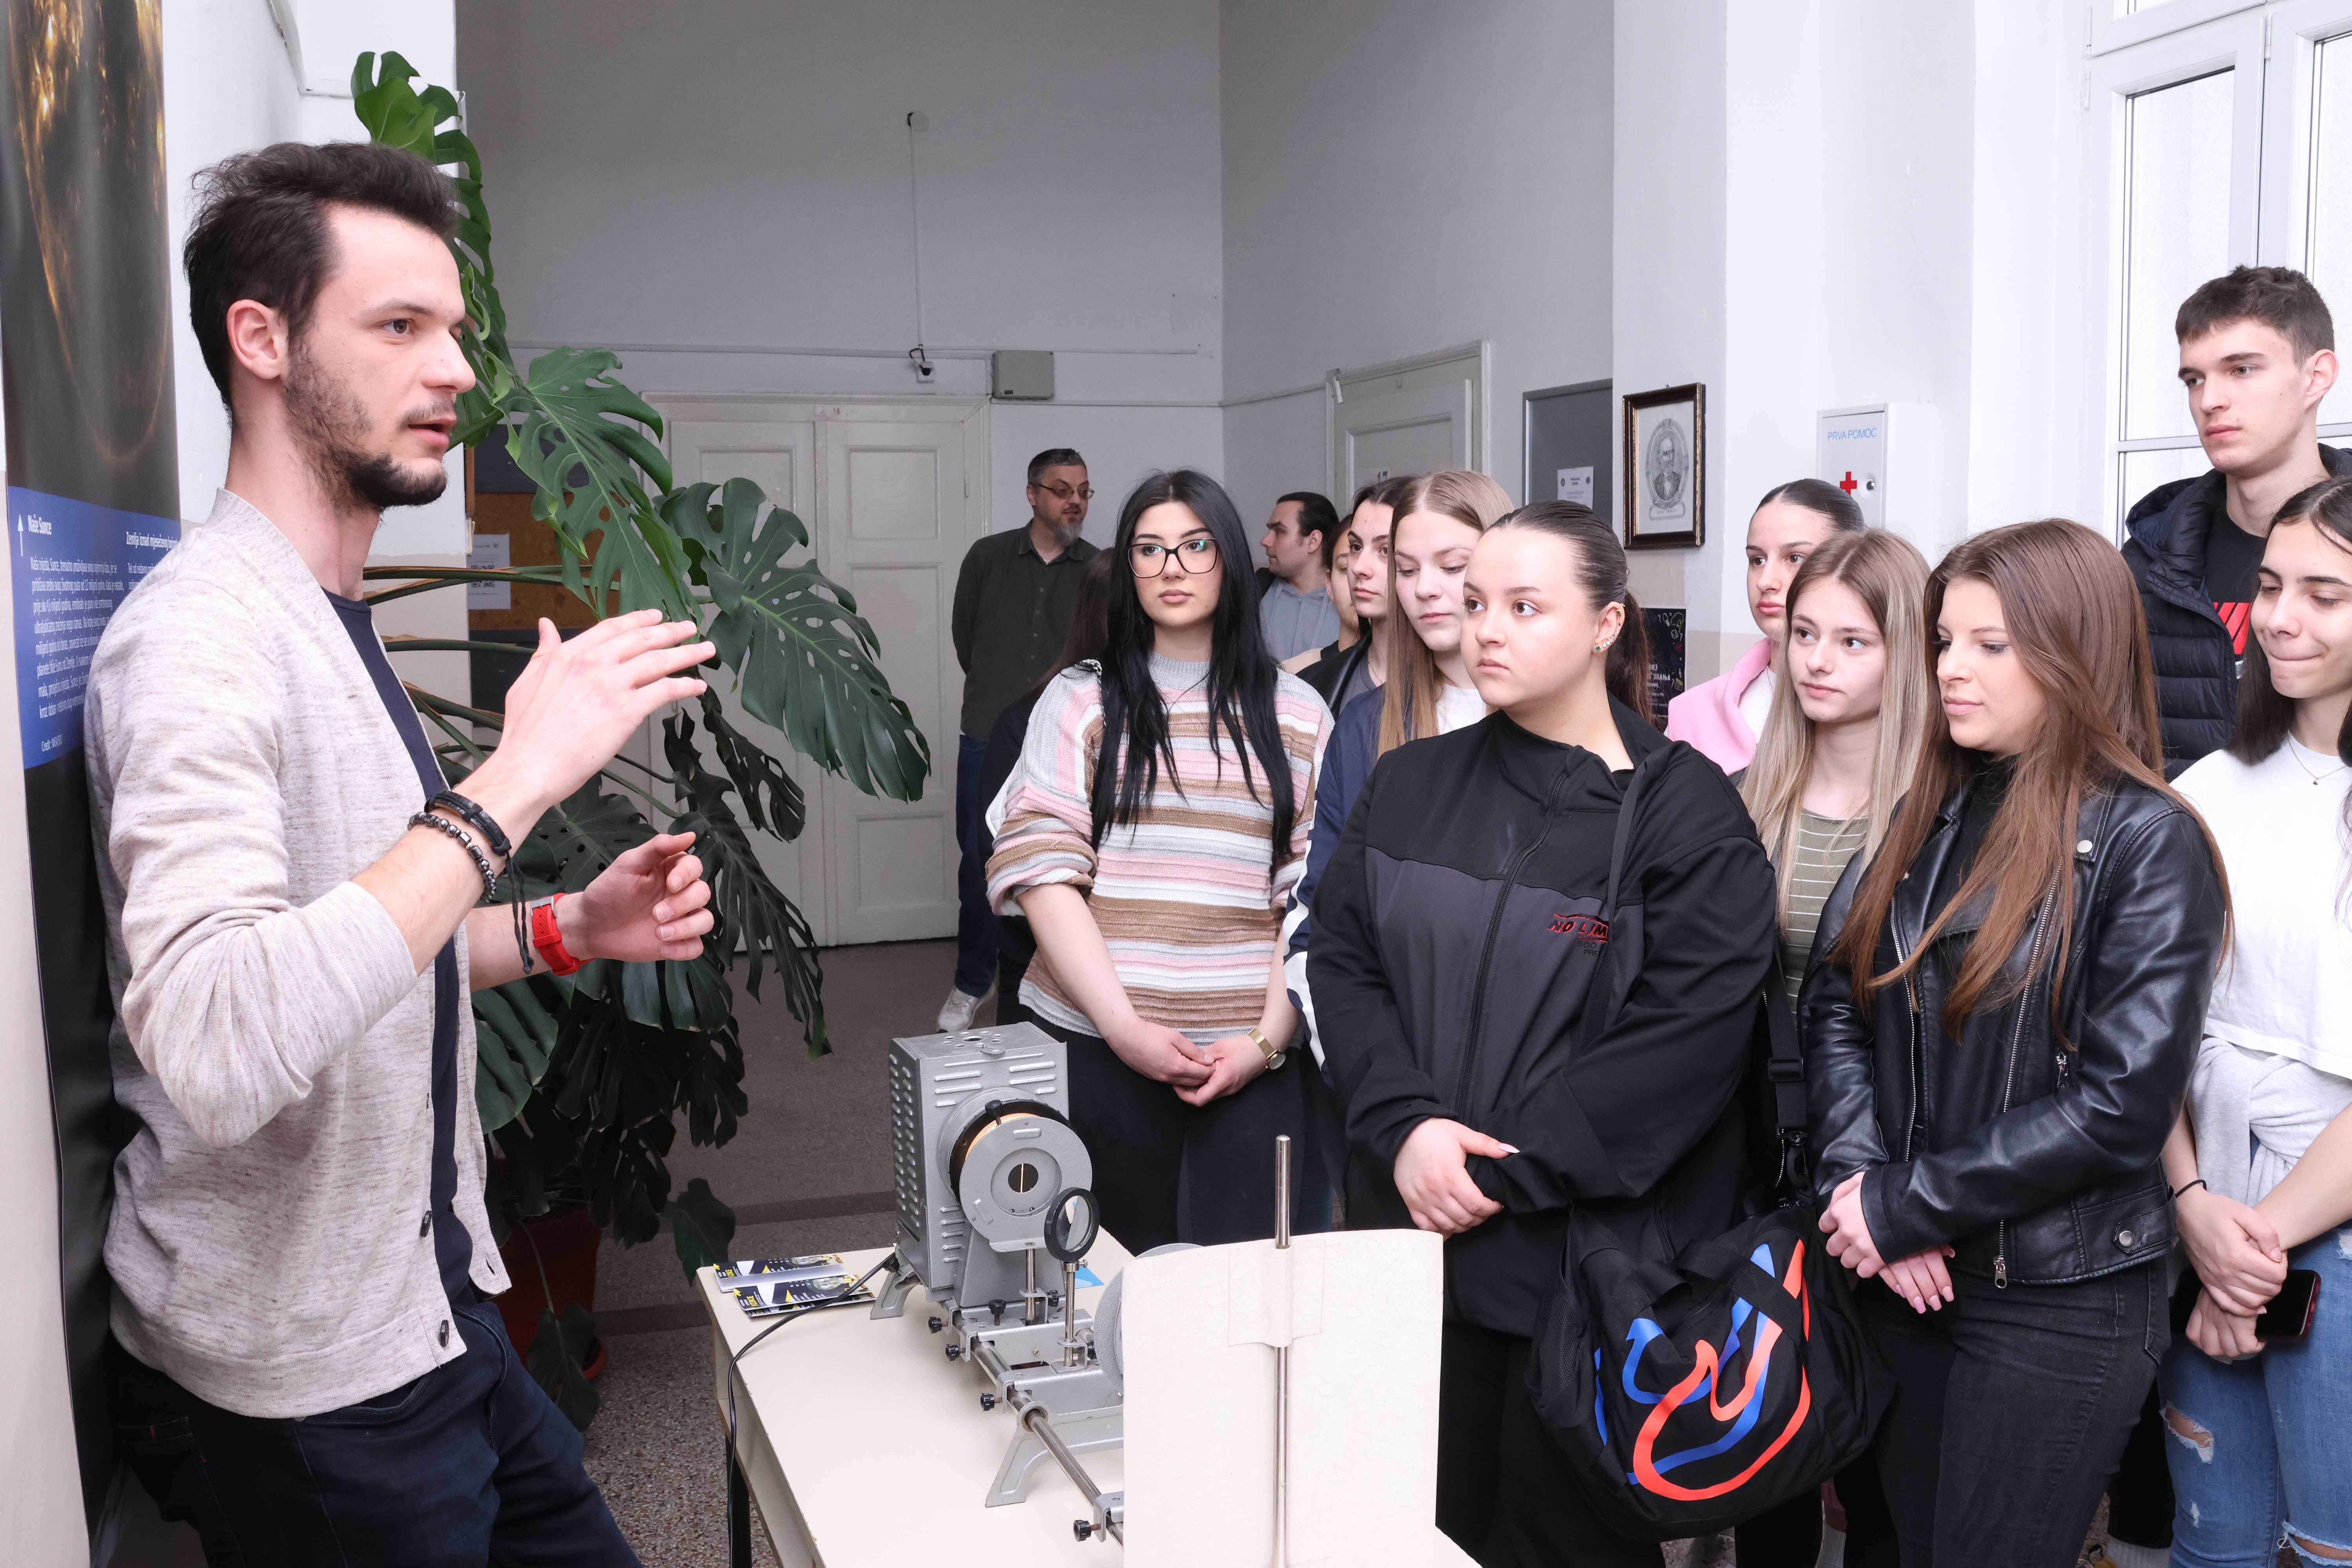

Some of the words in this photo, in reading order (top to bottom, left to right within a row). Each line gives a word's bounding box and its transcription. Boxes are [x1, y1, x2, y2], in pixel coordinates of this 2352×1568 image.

[1828, 431, 1847, 441] PRVA
[1848, 426, 1877, 439] POMOĆ
[28, 514, 39, 534] Naše
[39, 517, 52, 535] Sunce
[126, 531, 139, 549] Zemlja
[140, 532, 149, 547] iznad
[31, 555, 39, 570] Naša
[50, 558, 60, 574] Sunce,
[40, 705, 48, 719] kroz
[1546, 920, 1576, 934] NO
[1578, 921, 1608, 939] LIM
[746, 1296, 759, 1307] FIZIKE
